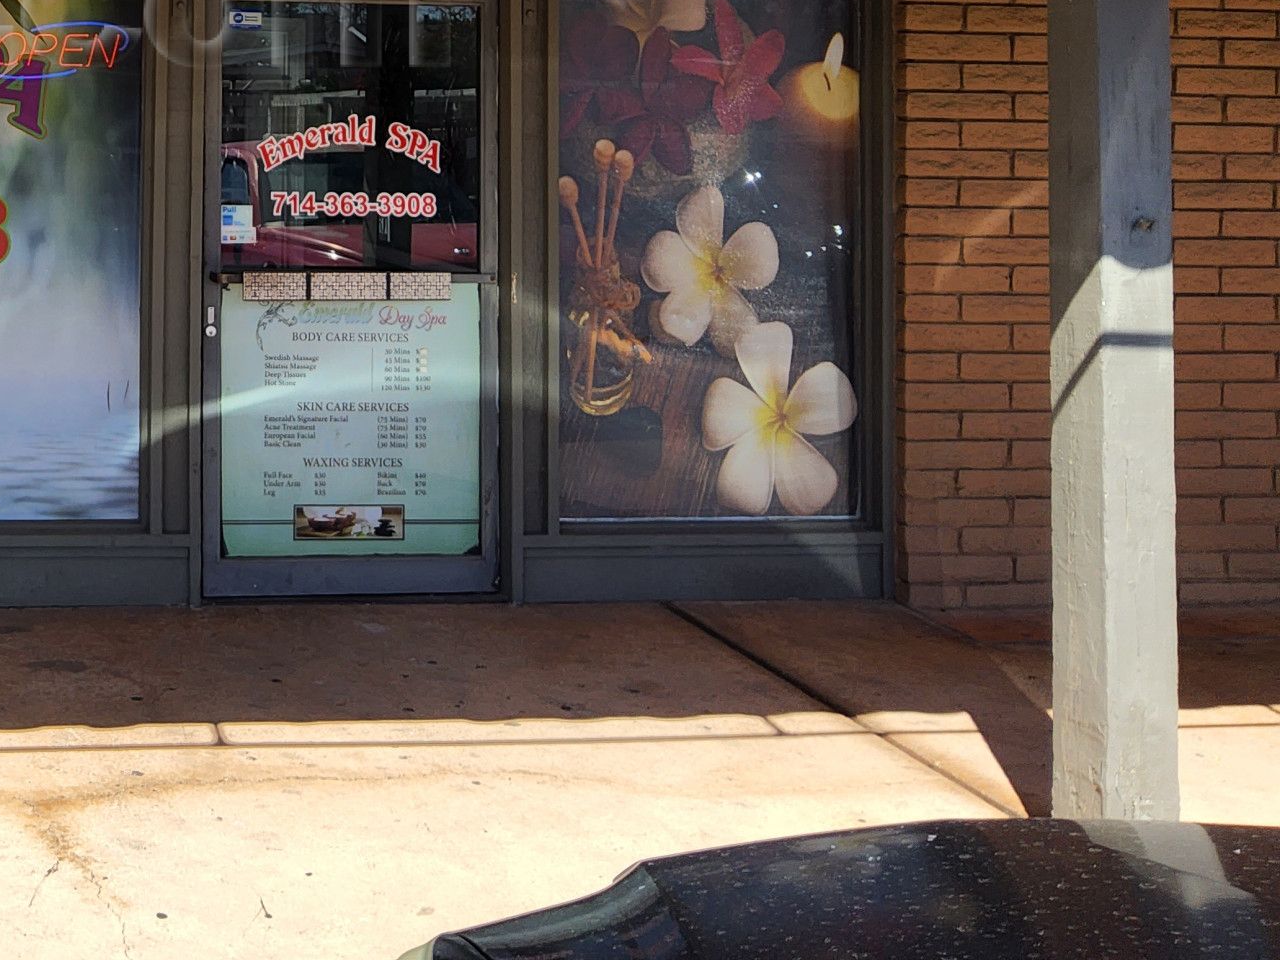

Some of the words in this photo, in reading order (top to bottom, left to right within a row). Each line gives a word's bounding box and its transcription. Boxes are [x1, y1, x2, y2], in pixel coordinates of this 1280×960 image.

[257, 114, 376, 172] Emerald
[386, 121, 441, 174] SPA
[271, 191, 436, 218] 714-363-3908
[379, 305, 414, 331] Day
[415, 306, 447, 331] Spa
[292, 332, 322, 341] BODY
[325, 332, 355, 342] CARE
[357, 332, 409, 342] SERVICES
[290, 363, 317, 371] Massage
[264, 371, 281, 379] Deep
[297, 402, 323, 411] SKIN
[326, 403, 355, 411] CARE
[358, 403, 409, 412] SERVICES
[264, 432, 294, 440] European
[303, 458, 349, 467] WAXING
[352, 458, 403, 467] SERVICES
